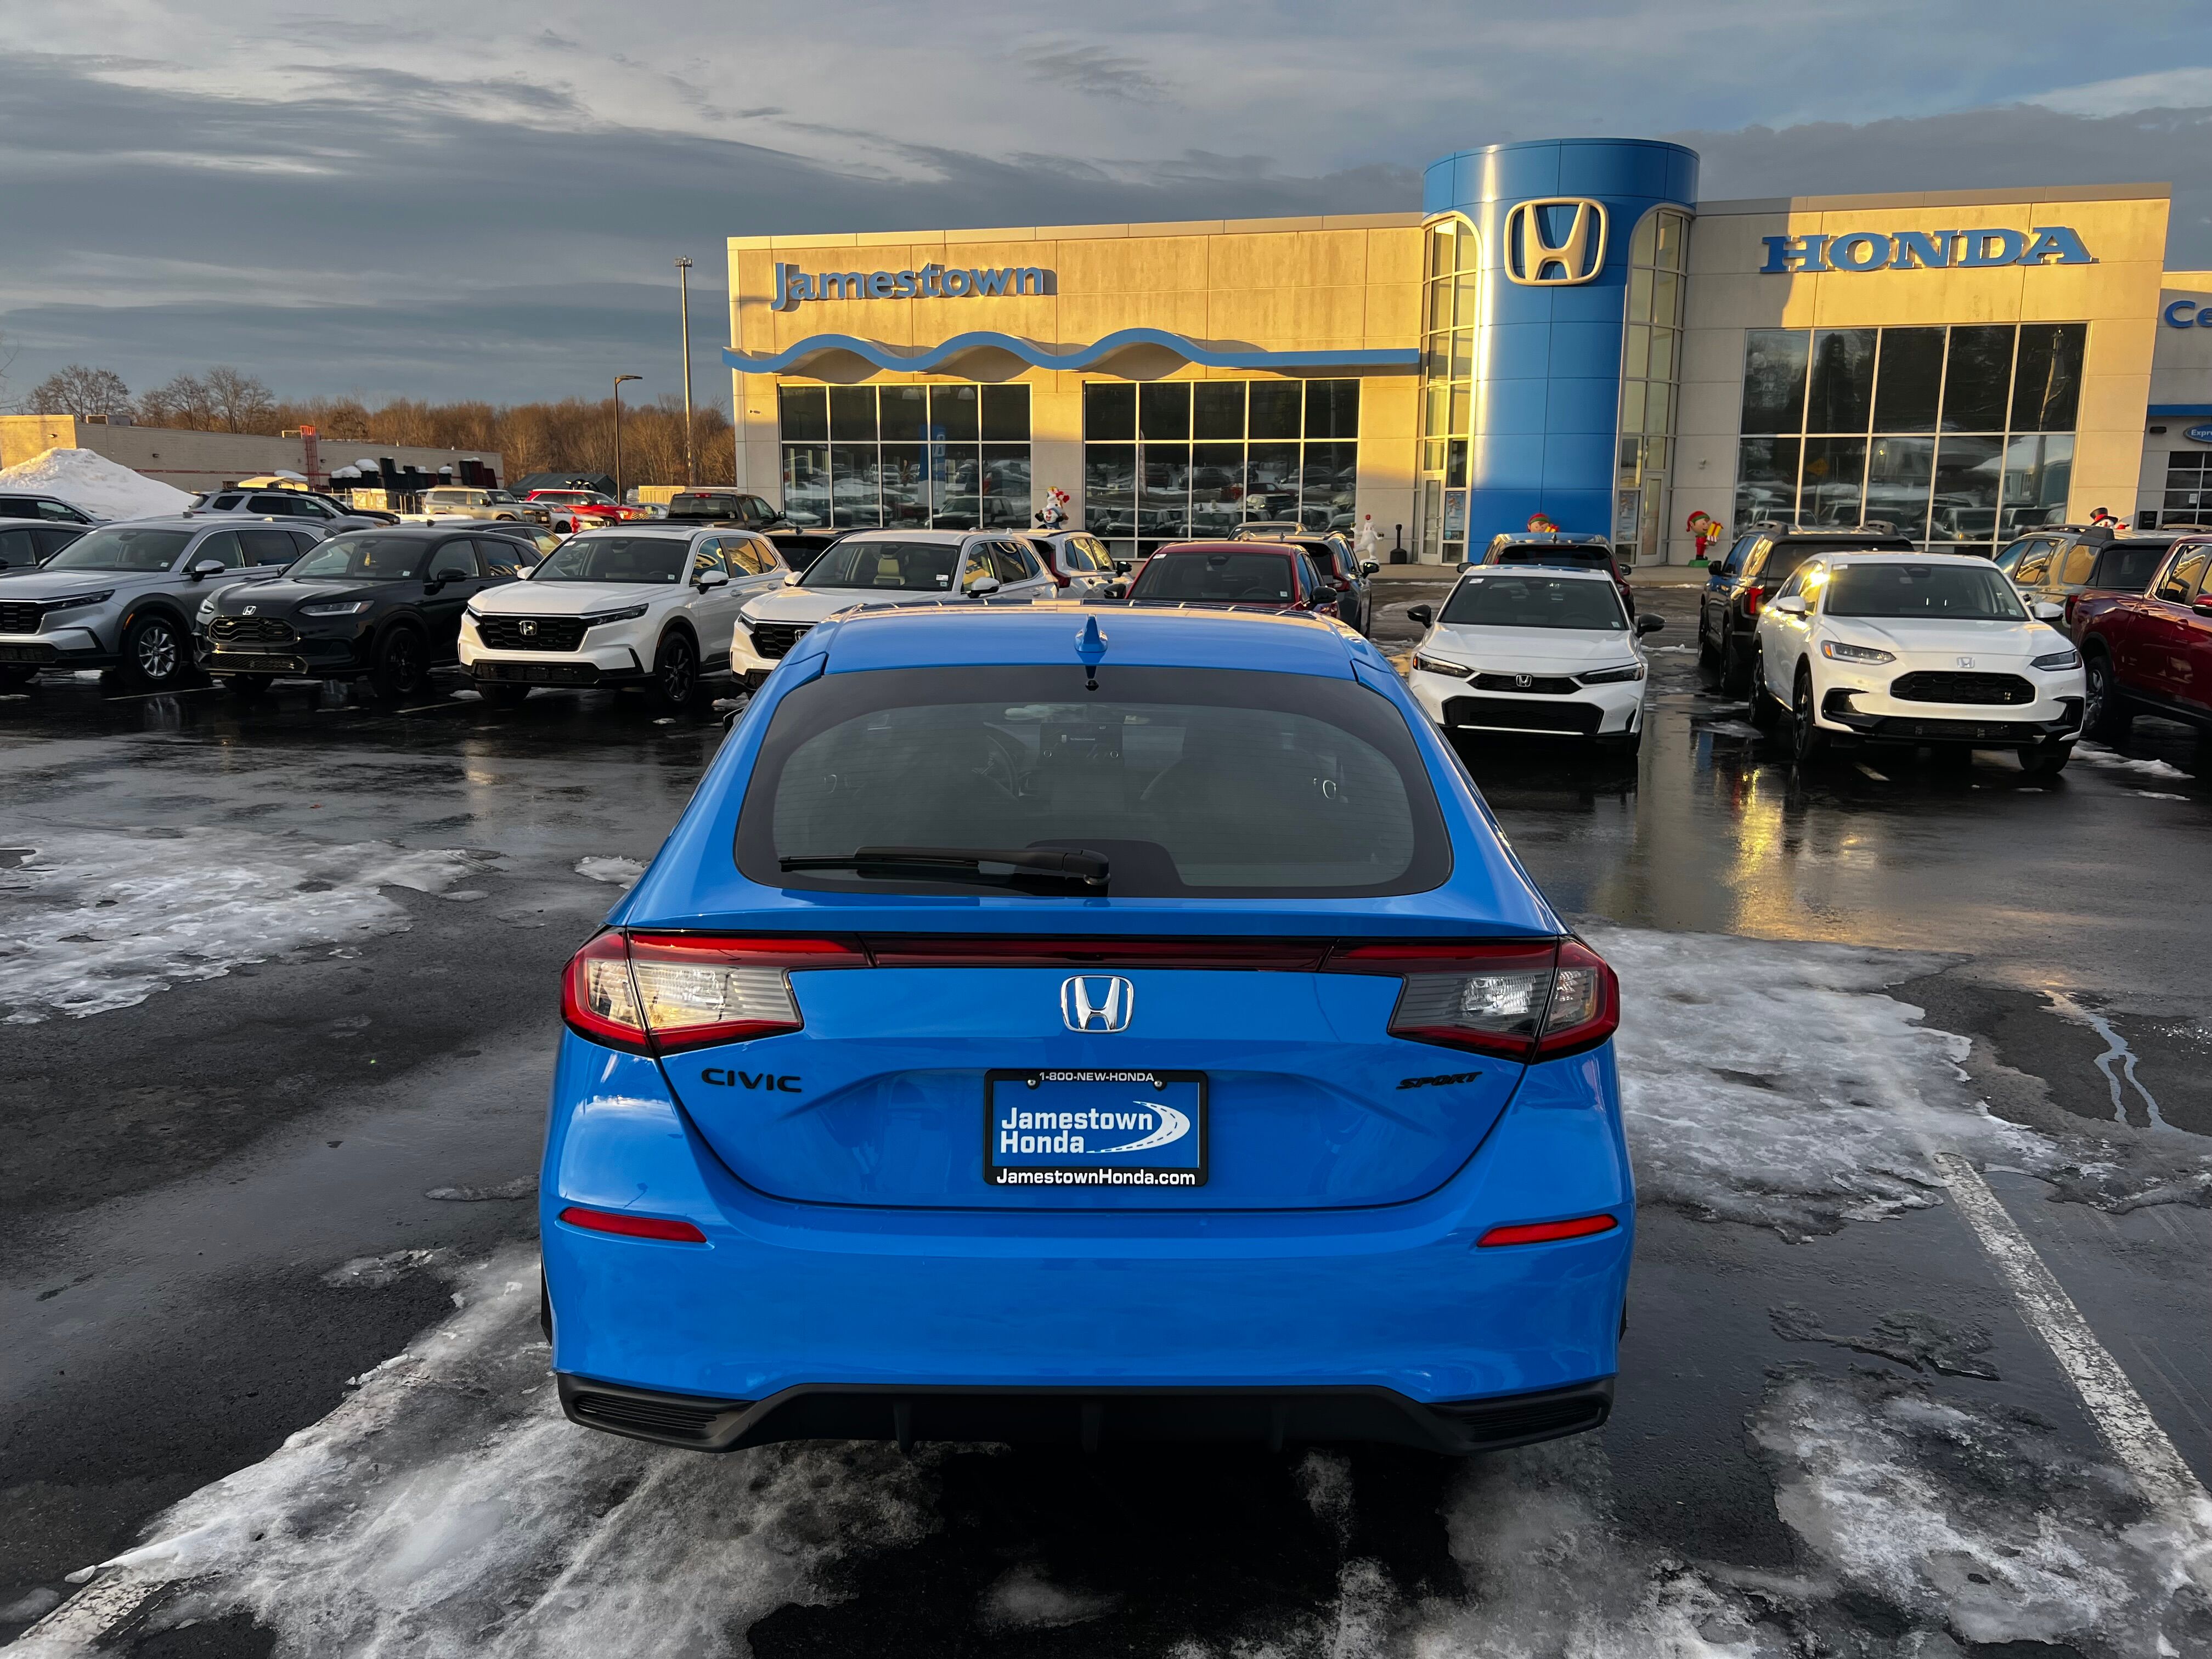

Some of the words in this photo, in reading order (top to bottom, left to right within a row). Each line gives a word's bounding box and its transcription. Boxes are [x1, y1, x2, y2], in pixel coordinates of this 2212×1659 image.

[1759, 225, 2100, 273] HONDA
[770, 262, 1045, 311] Jamestown
[701, 1068, 802, 1093] CIVIC
[1039, 1071, 1154, 1082] 1-800-NEW-HONDA
[1395, 1071, 1483, 1090] SPORT
[1001, 1107, 1153, 1130] Jamestown
[1000, 1130, 1085, 1154] Honda
[996, 1168, 1195, 1185] JamestownHonda.com
